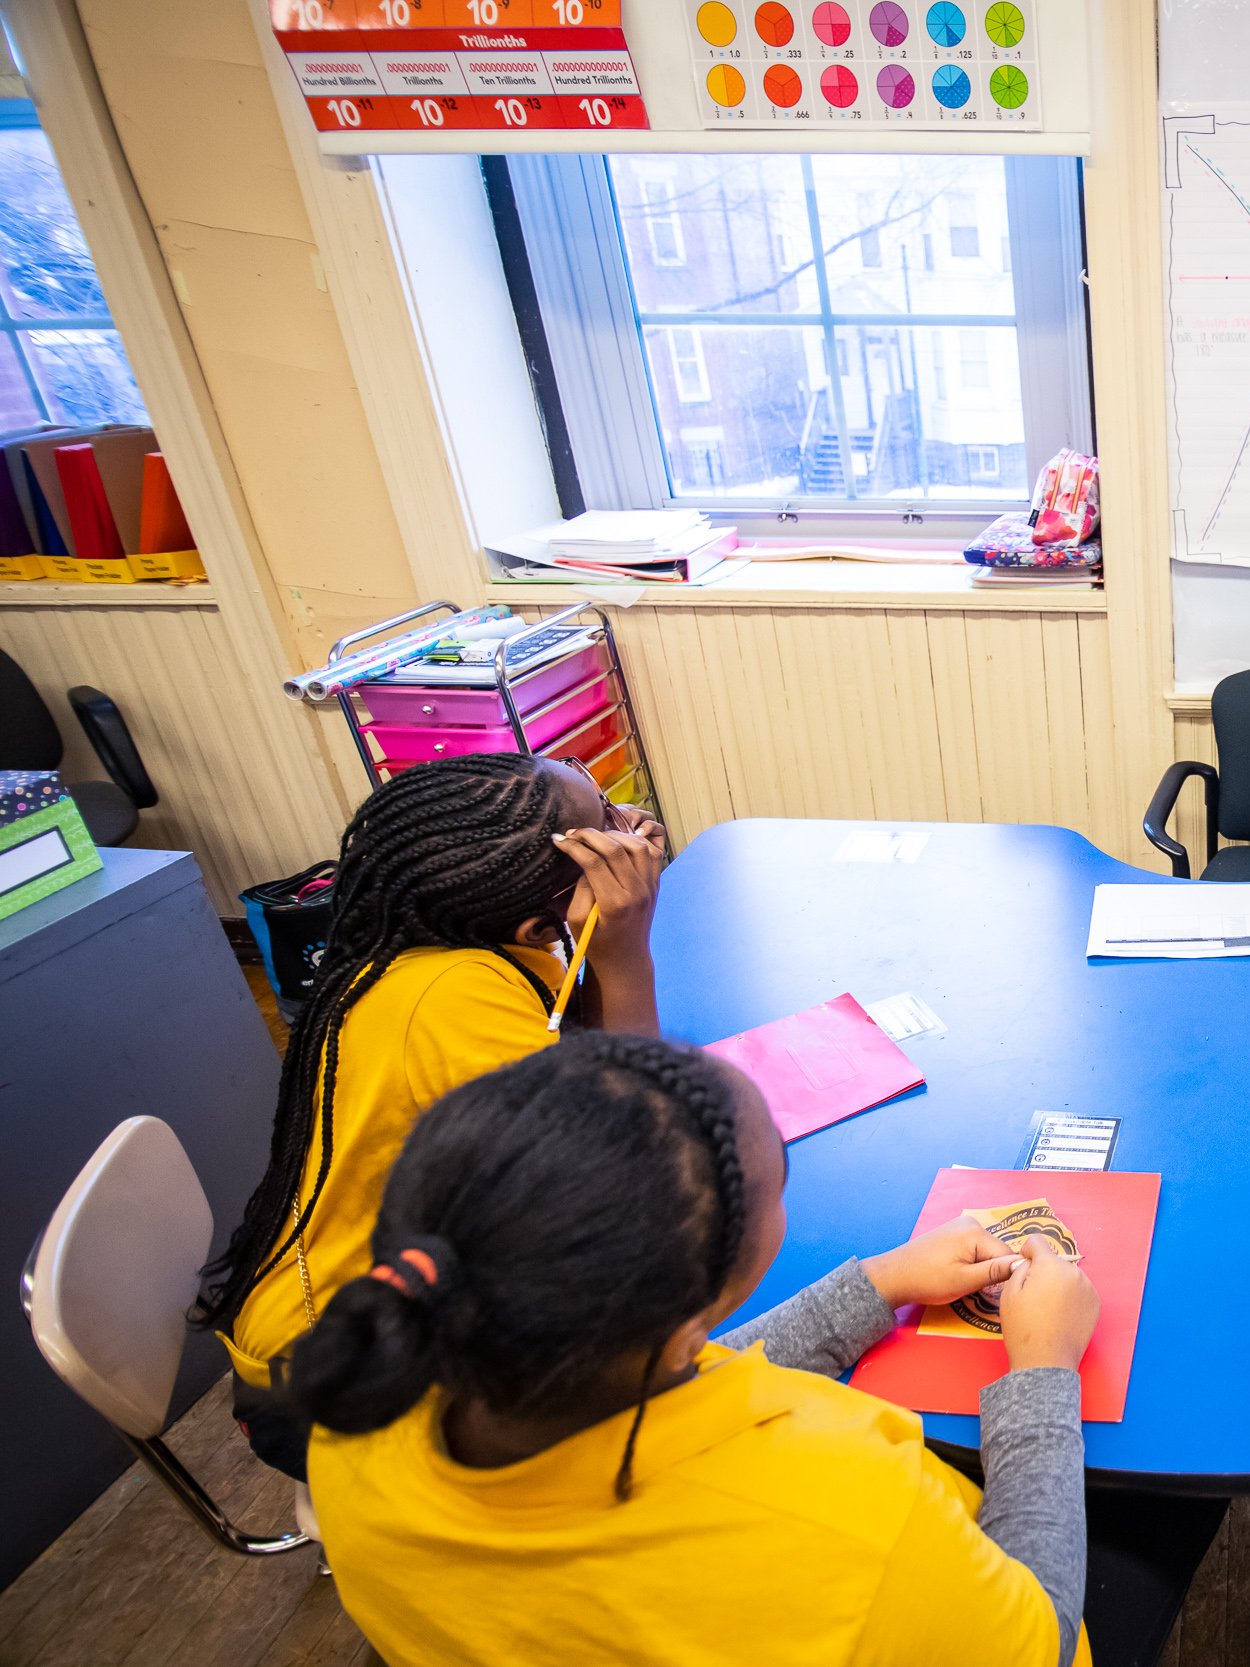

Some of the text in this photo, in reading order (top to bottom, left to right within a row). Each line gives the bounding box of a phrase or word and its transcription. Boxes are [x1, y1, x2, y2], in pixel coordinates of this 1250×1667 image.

[459, 35, 527, 48] Trillionths
[302, 76, 377, 86] Hundred Billionths
[402, 76, 444, 86] Trillionths
[479, 76, 537, 86] Ten Trillionths
[555, 76, 633, 85] Hundred Trillionths
[1029, 1208, 1039, 1217] Is
